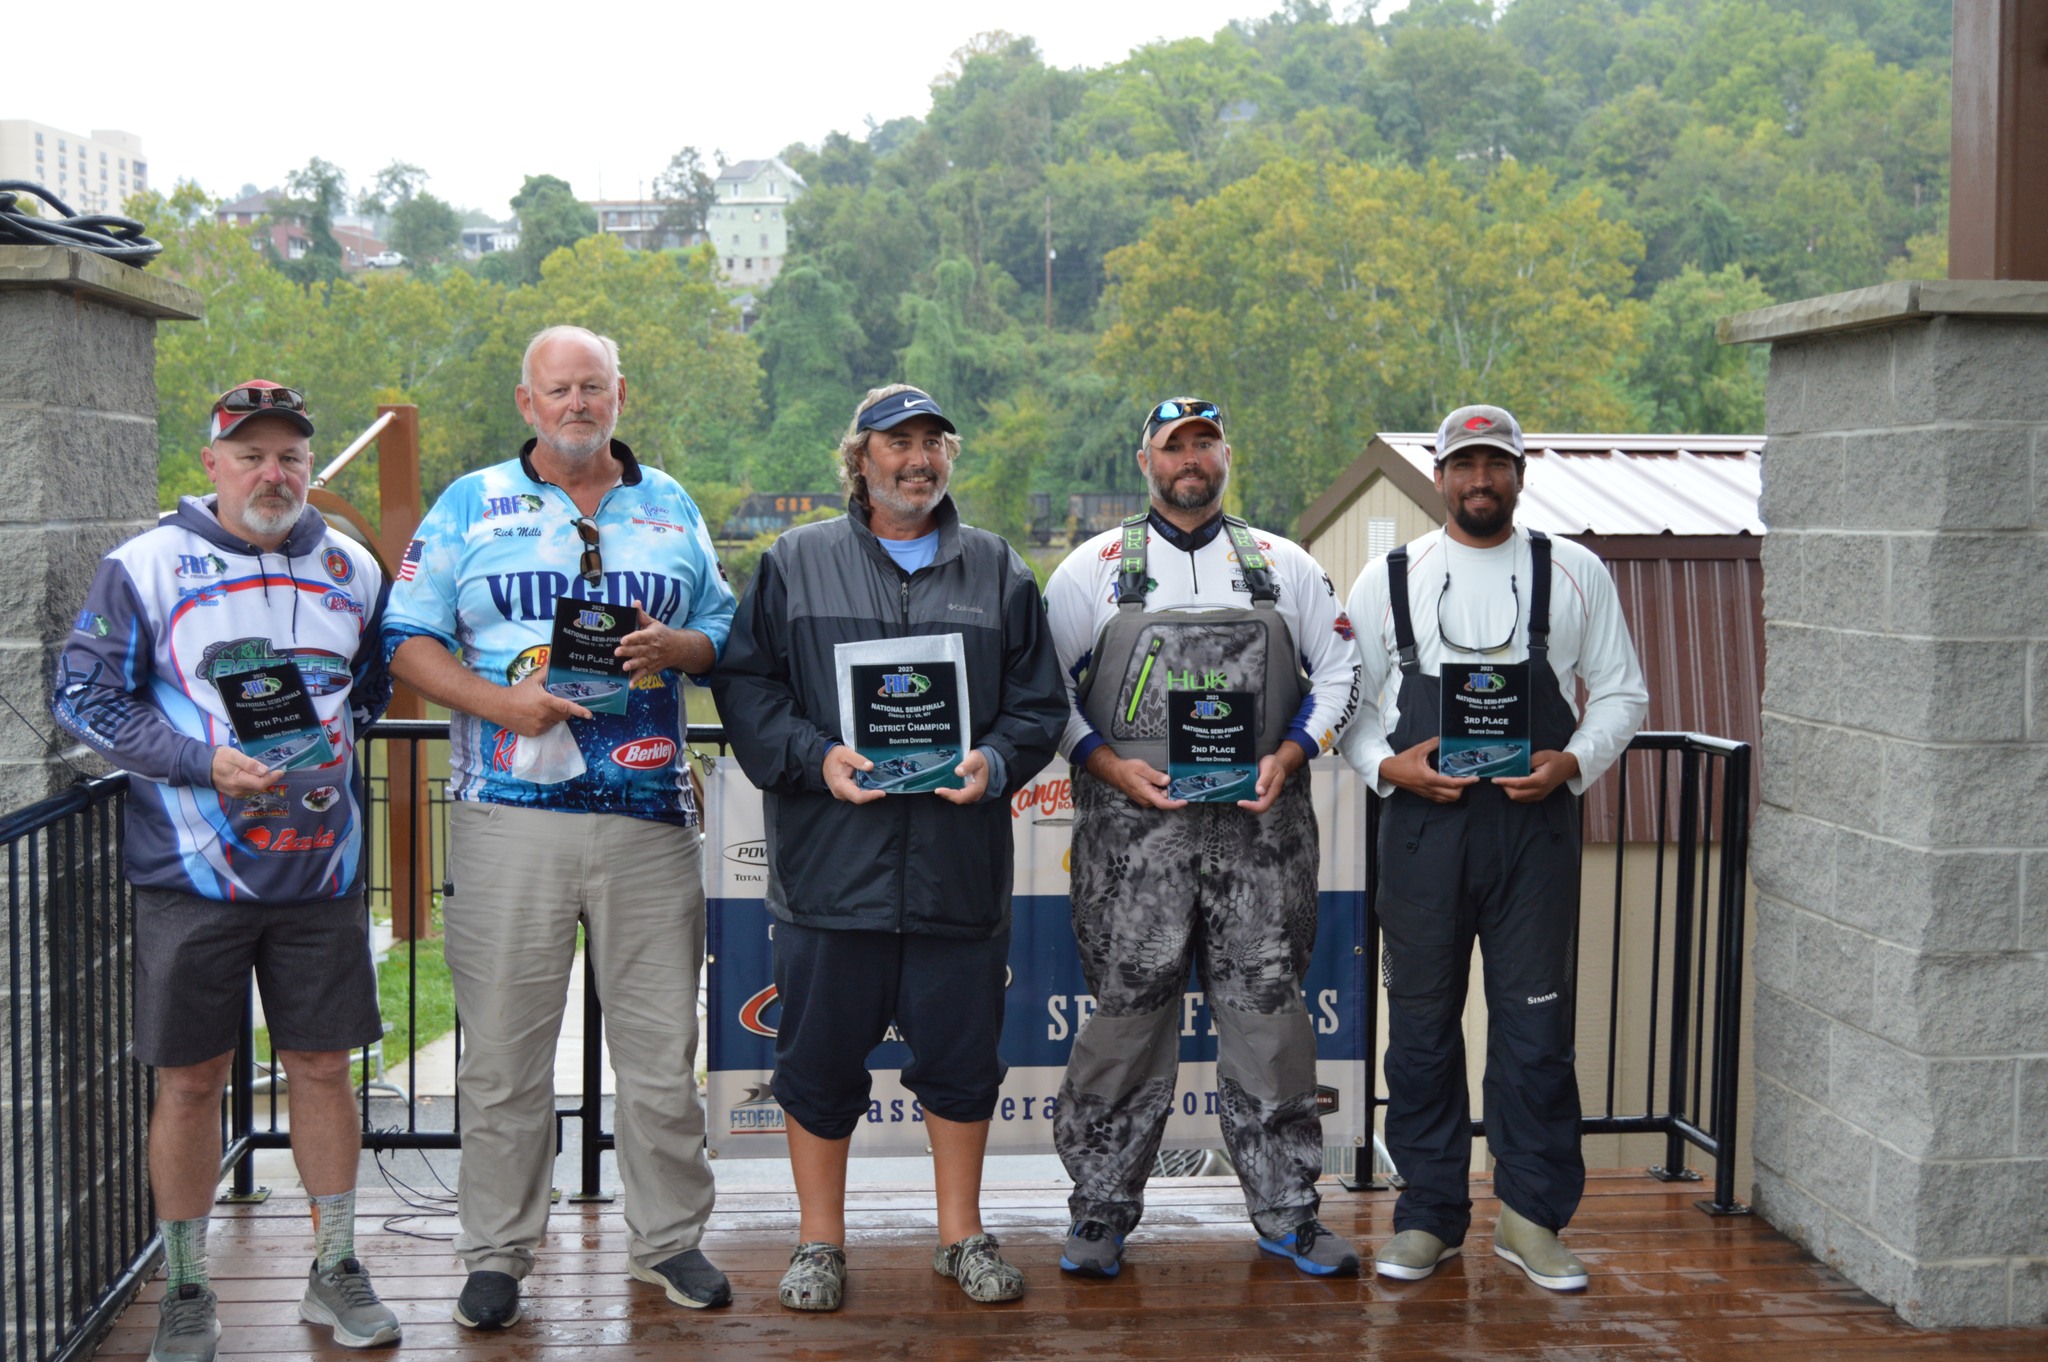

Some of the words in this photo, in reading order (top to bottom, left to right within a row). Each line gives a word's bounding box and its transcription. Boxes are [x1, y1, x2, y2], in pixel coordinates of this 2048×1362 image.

[488, 495, 522, 516] TBF
[493, 528, 514, 538] Rick
[517, 526, 542, 537] Mills
[486, 571, 681, 624] VIRGINIA
[563, 627, 591, 641] NATIONAL
[591, 635, 622, 643] SEMI-FINA
[569, 652, 585, 661] 4TH
[587, 654, 615, 665] PLACE
[882, 674, 911, 694] TBF
[236, 700, 266, 708] NATIONAL
[1456, 694, 1483, 704] NATIONAL
[1484, 695, 1518, 705] SEMI-FINALS
[871, 703, 904, 713] NATIONAL
[905, 701, 946, 713] SEMI-FINALS
[254, 720, 271, 729] 5TH
[272, 714, 301, 724] PLACE
[1464, 716, 1481, 724] 3RD
[1482, 716, 1509, 725] PLACE
[869, 724, 905, 732] DISTRICT
[907, 722, 950, 731] CHAMPION
[1182, 724, 1210, 734] NATIONAL
[1210, 725, 1244, 735] SEMI-FINALS
[624, 743, 672, 762] Berkley
[1191, 745, 1208, 753] 2ND
[1210, 745, 1236, 753] PLACE
[730, 1109, 784, 1128] FEDERA
